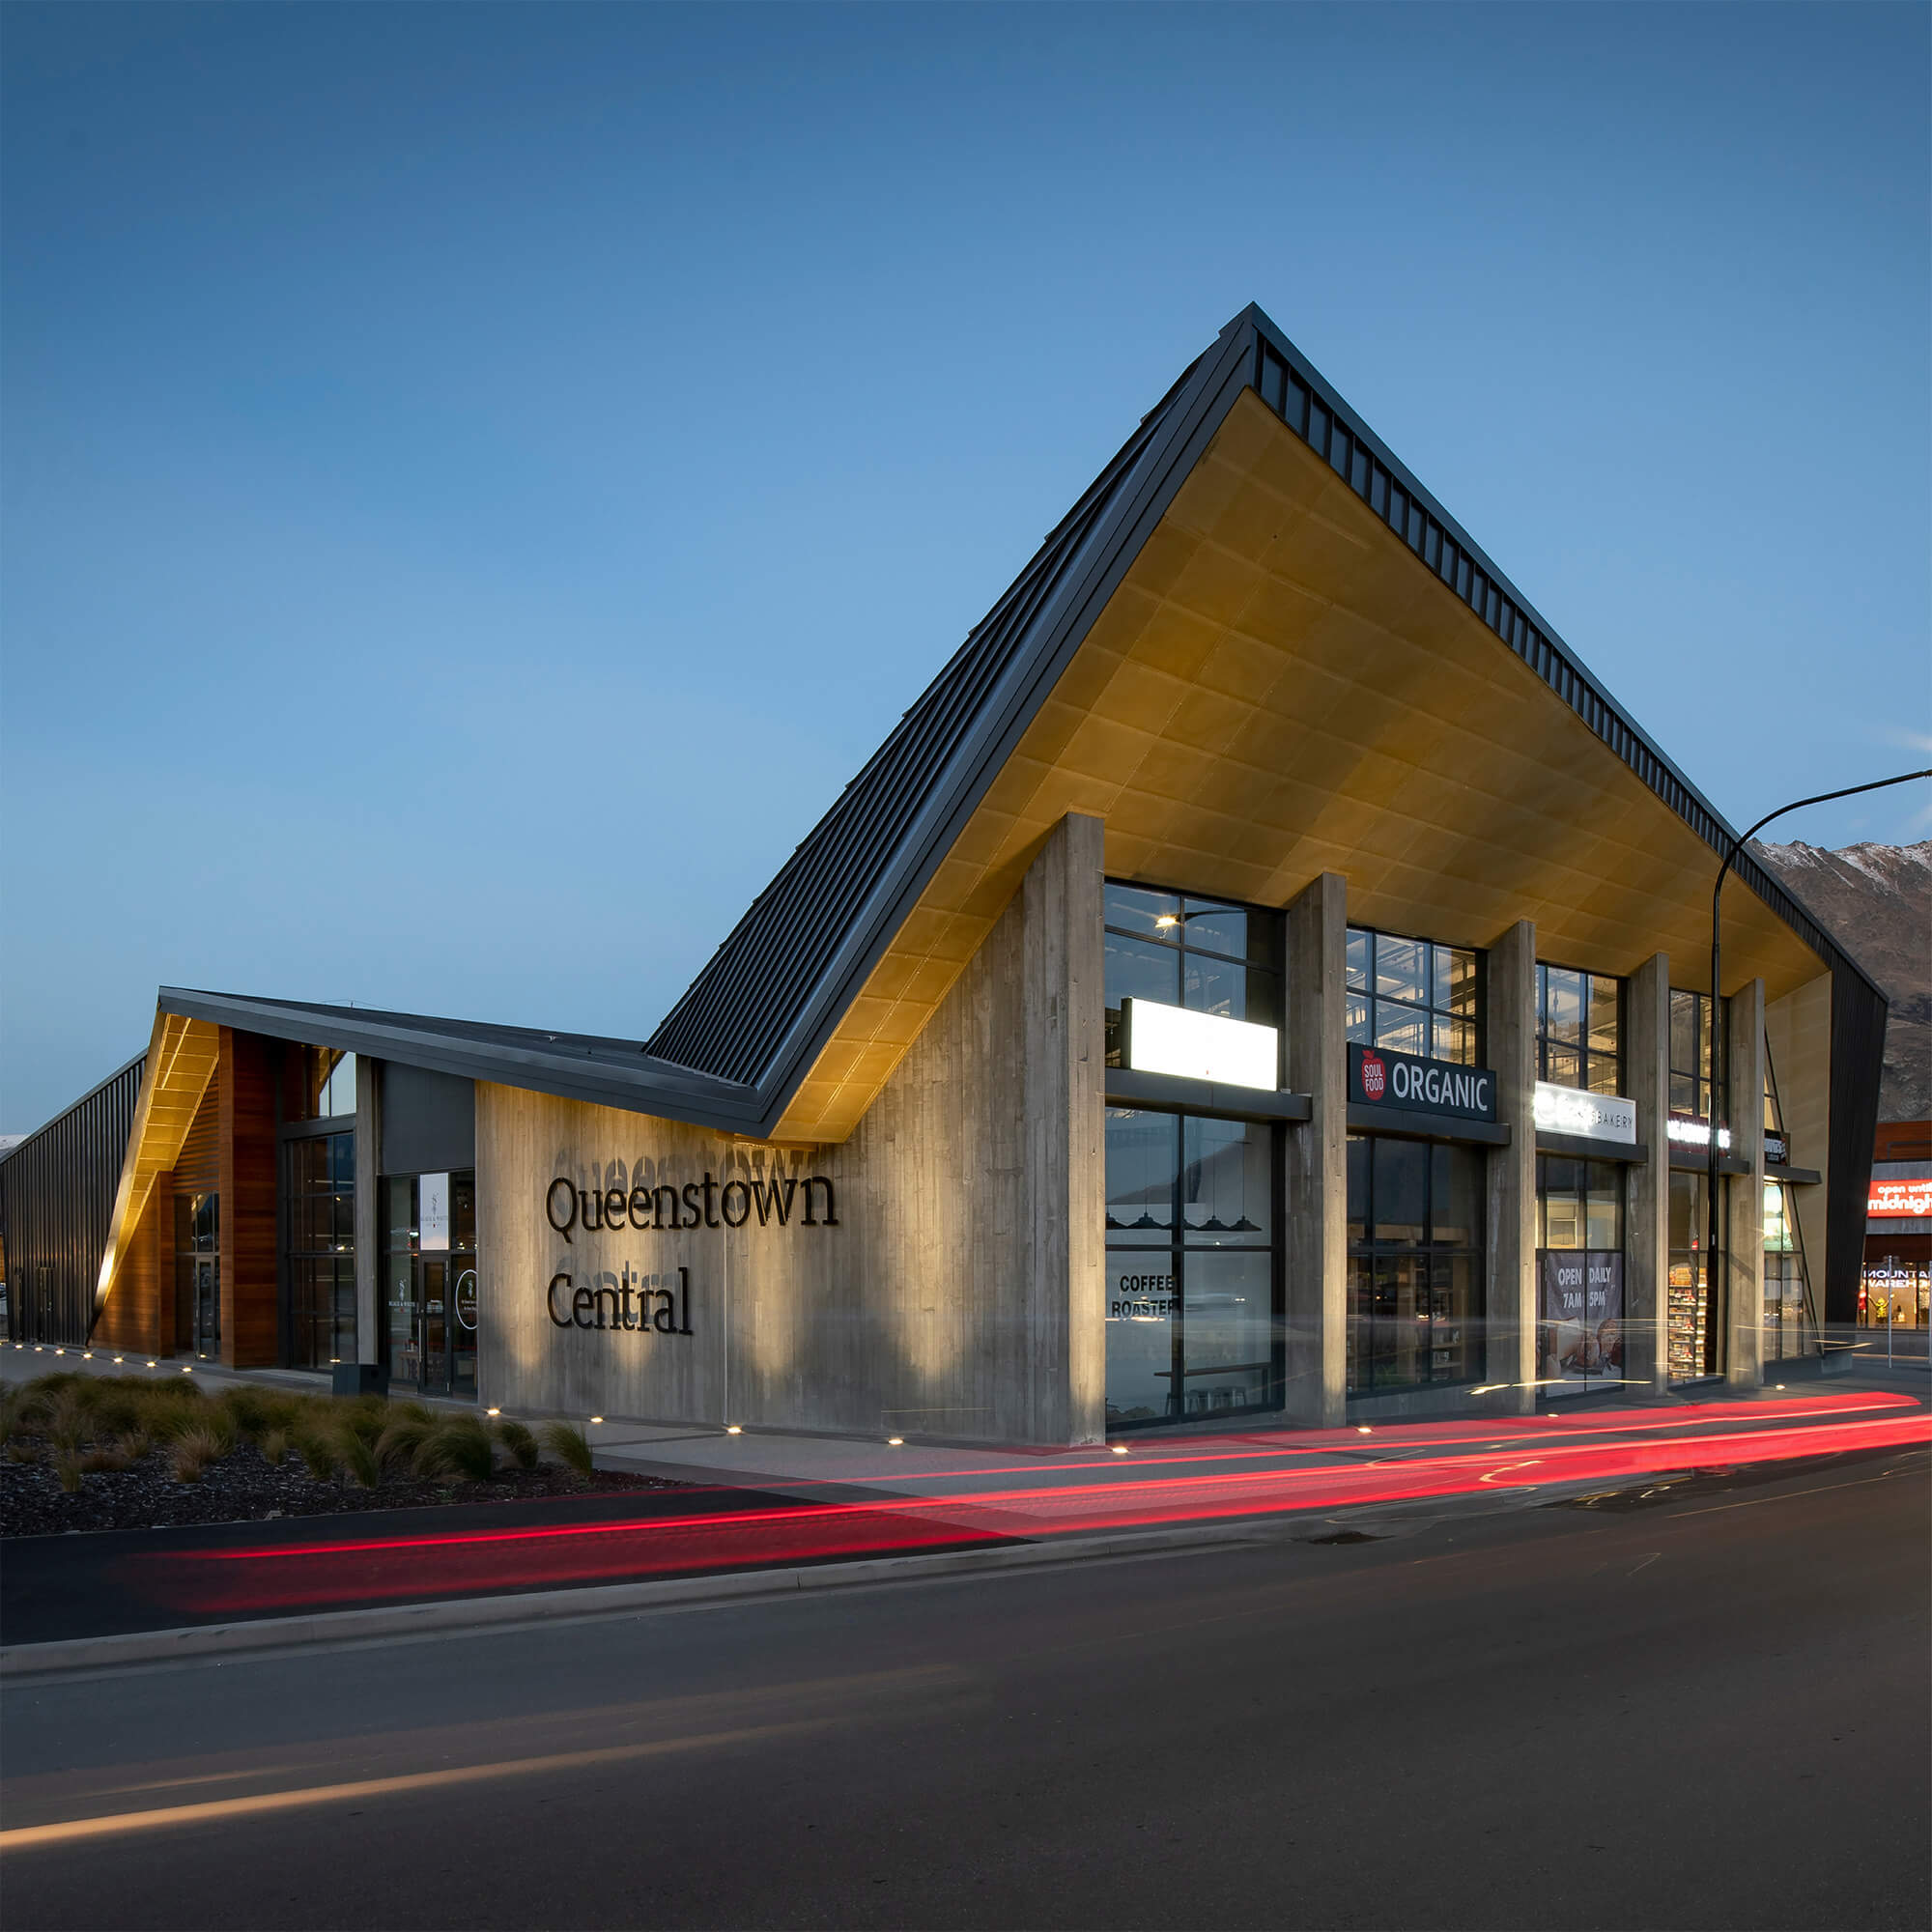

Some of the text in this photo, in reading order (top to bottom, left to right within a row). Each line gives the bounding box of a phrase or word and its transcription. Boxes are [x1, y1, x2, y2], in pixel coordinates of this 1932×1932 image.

[1364, 1065, 1383, 1078] SOUL
[1365, 1077, 1384, 1092] FOOD
[1392, 1062, 1489, 1112] ORGANIC
[1595, 1110, 1632, 1128] BAKERY
[1877, 1186, 1906, 1197] open
[546, 1172, 839, 1244] Queenstown
[1120, 1275, 1175, 1292] COFFEE
[1557, 1266, 1611, 1286] OPEN DAILY
[547, 1266, 693, 1336] Central
[1563, 1291, 1605, 1309] 7AM 5PM
